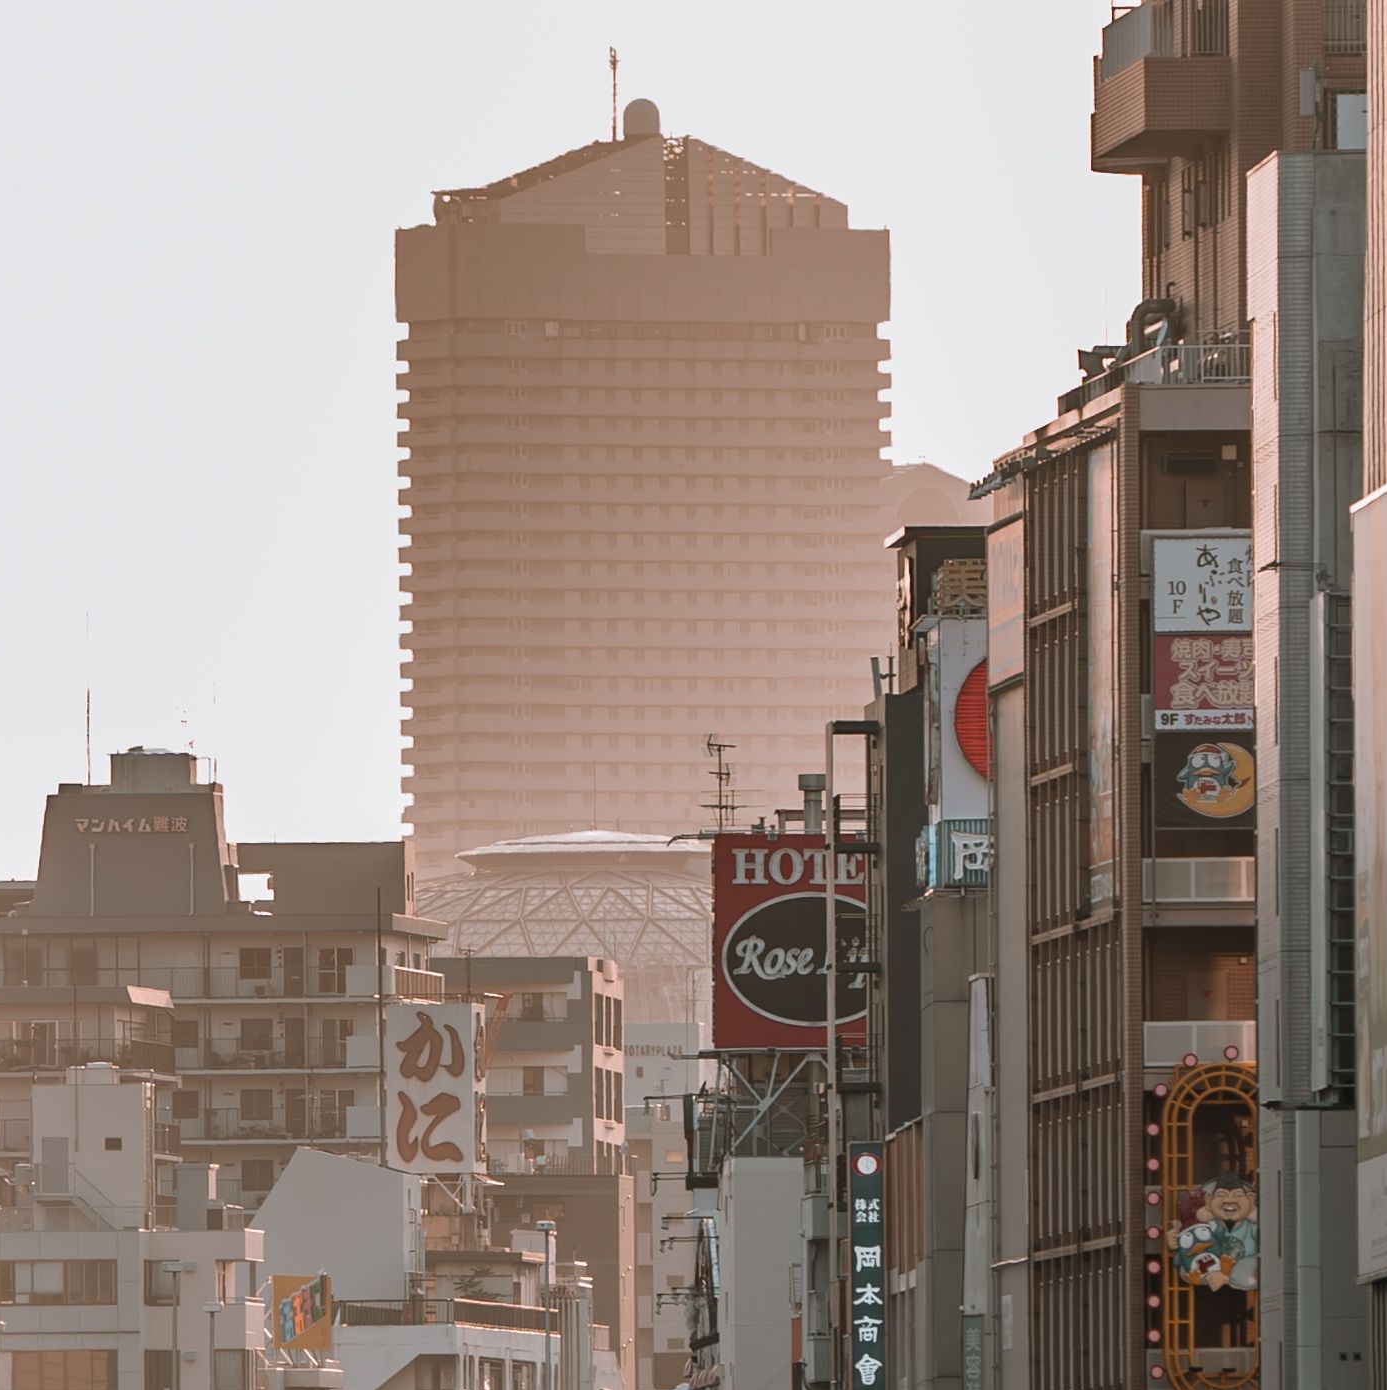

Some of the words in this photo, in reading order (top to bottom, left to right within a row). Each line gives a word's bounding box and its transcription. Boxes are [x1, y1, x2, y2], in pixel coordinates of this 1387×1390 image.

[1168, 580, 1187, 596] 10
[1195, 543, 1225, 627] あぶりや
[1227, 557, 1244, 625] 食べ放題
[1173, 599, 1184, 614] F
[1160, 712, 1179, 726] 9F
[74, 816, 188, 833] マンハイム難波
[733, 934, 814, 981] Rose
[395, 1010, 466, 1164] かに
